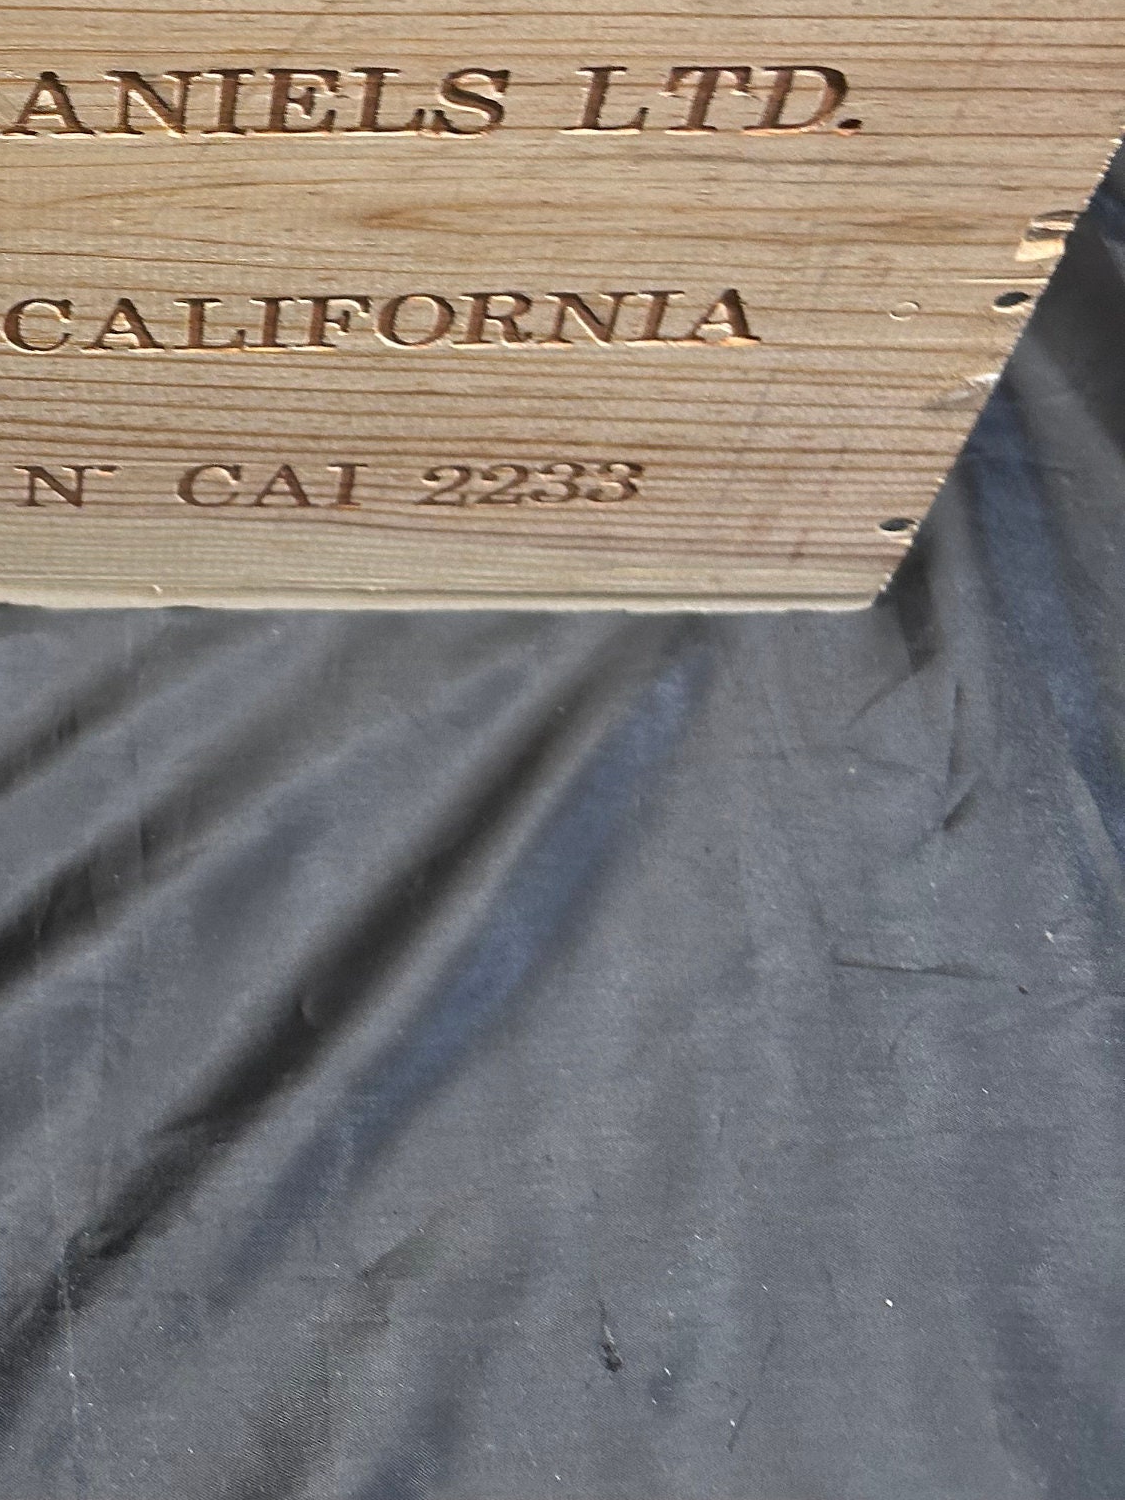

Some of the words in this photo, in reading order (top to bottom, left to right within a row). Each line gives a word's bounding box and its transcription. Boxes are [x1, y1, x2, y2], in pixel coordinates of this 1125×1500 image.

[563, 65, 865, 137] LTD.
[1, 288, 763, 355] CALIFORNIA
[175, 463, 370, 510] CAI
[420, 461, 646, 509] 2233
